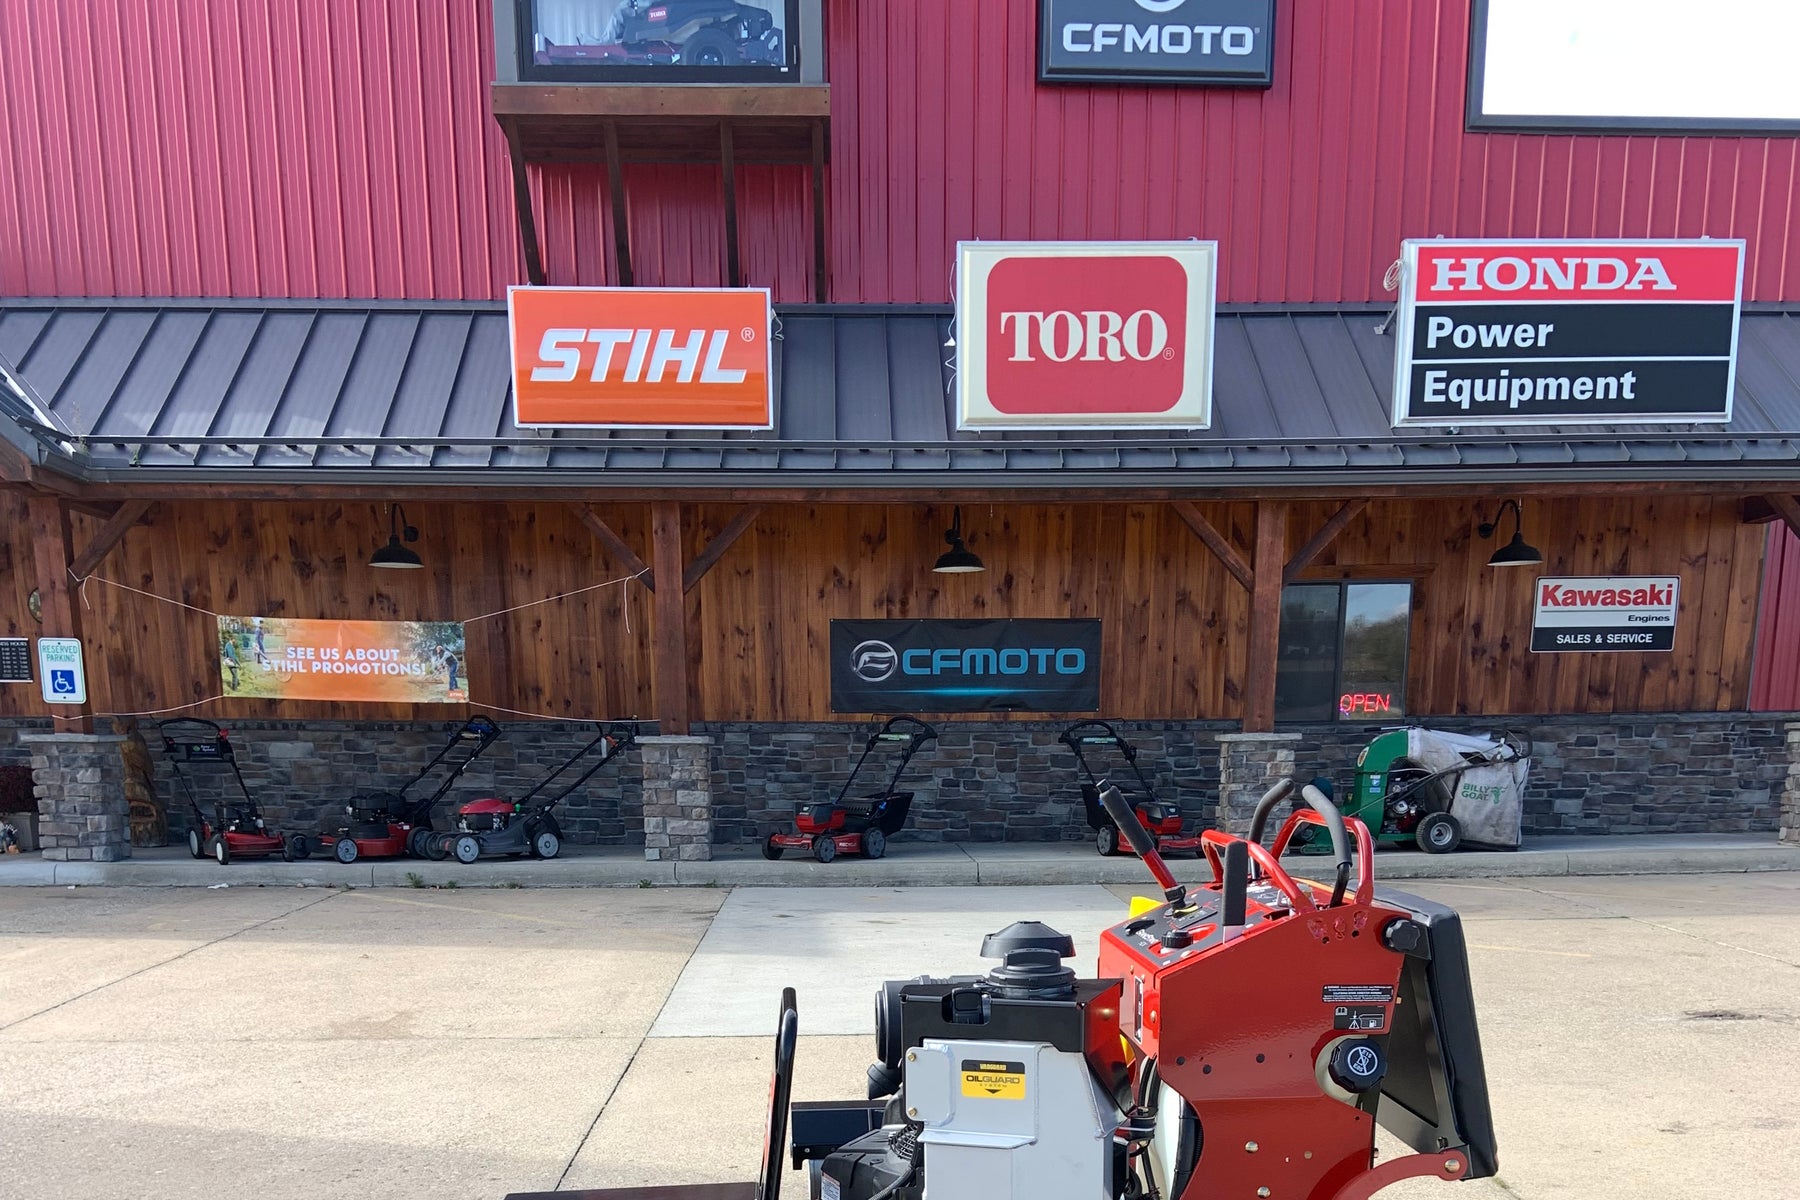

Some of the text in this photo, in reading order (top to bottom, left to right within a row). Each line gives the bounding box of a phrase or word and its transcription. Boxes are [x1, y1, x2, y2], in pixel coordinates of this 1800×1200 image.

[1063, 23, 1254, 55] CFMOTO
[1430, 257, 1677, 291] HONDA
[1001, 310, 1168, 362] TORO
[1427, 316, 1554, 349] Power
[530, 328, 747, 384] STIHL
[1424, 369, 1636, 409] Equipment
[1541, 584, 1673, 607] Kawasaki
[1628, 615, 1670, 623] Engines
[1556, 634, 1653, 644] SALES & SERVICE
[42, 645, 78, 653] RESERVED
[286, 647, 400, 662] SEE US ABOUT
[46, 654, 75, 662] PARKING
[902, 648, 1086, 675] CFMOTO
[262, 659, 426, 676] STIHL PROMOTIONS!
[1340, 694, 1390, 712] OPEN
[1461, 790, 1489, 801] GOAT
[1463, 782, 1490, 793] BILLY
[966, 1075, 1020, 1084] OILGUARD
